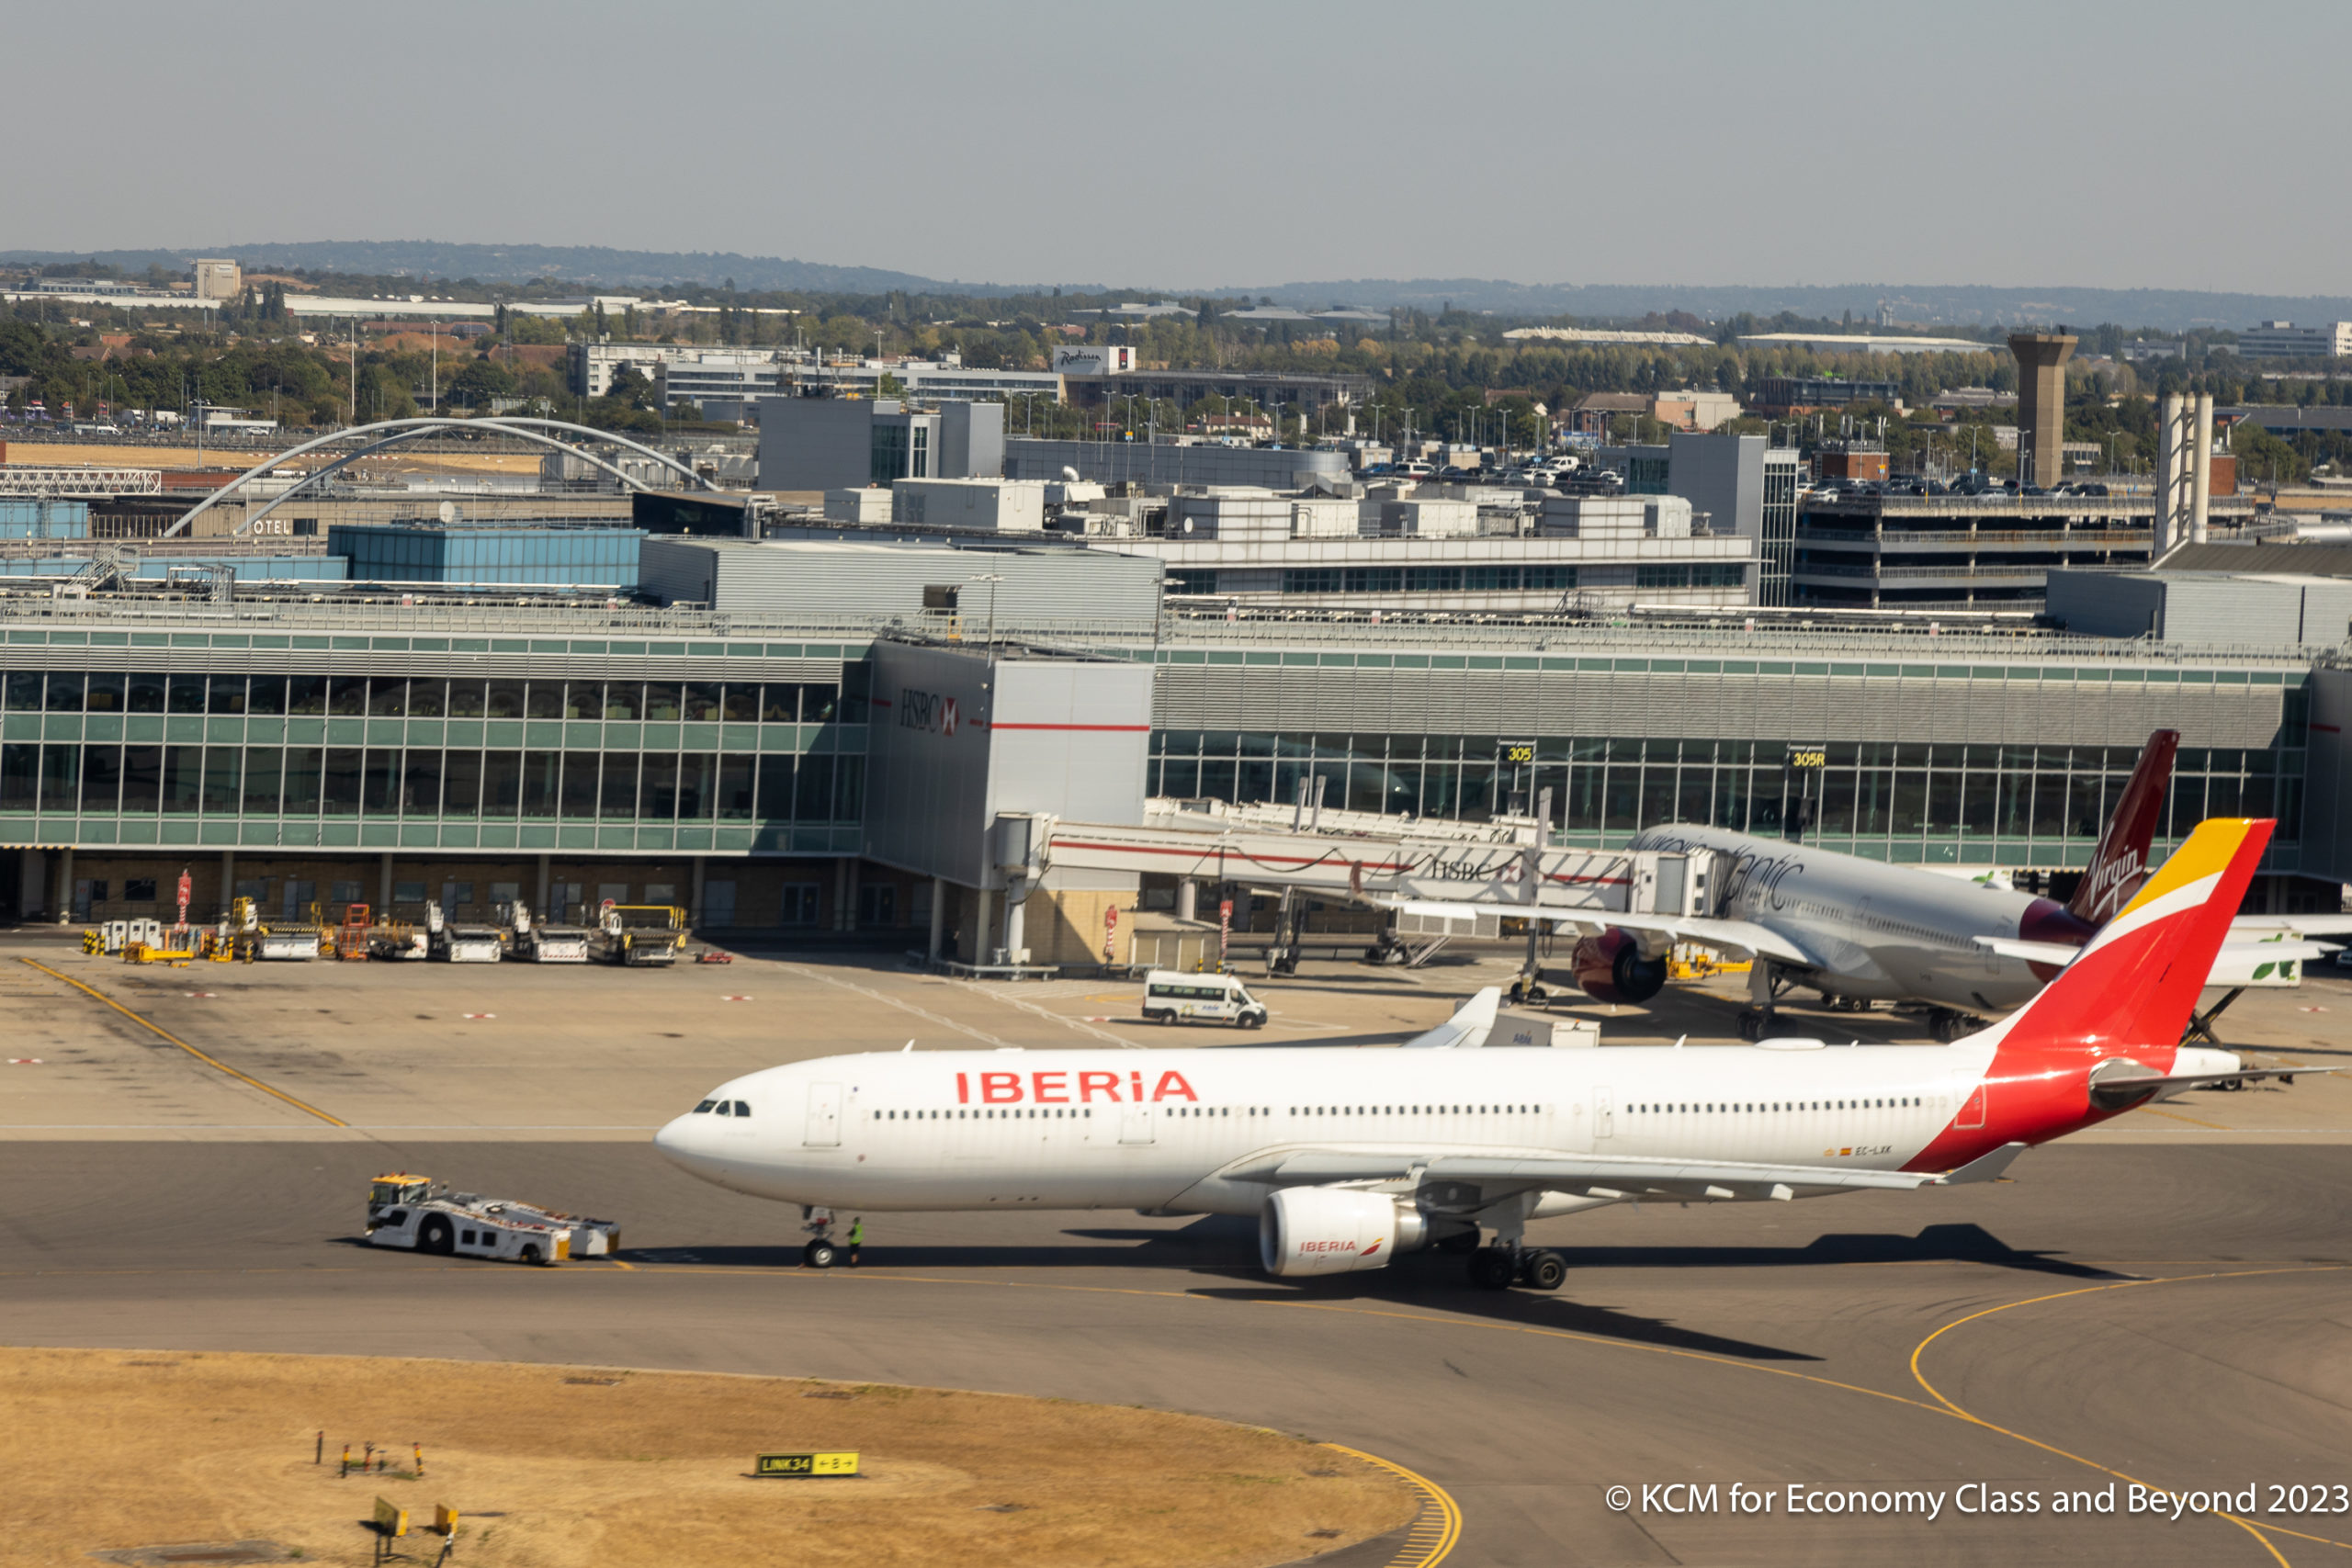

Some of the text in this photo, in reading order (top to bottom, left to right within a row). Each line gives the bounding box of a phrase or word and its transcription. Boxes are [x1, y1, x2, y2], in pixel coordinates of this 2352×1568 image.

[248, 520, 289, 535] OTEL
[900, 688, 940, 734] HSBC
[1508, 746, 1532, 761] 305
[1792, 751, 1826, 767] 305R
[1431, 859, 1492, 883] HSBC
[2088, 819, 2143, 918] Virgin
[1298, 1239, 1357, 1253] IBERIA
